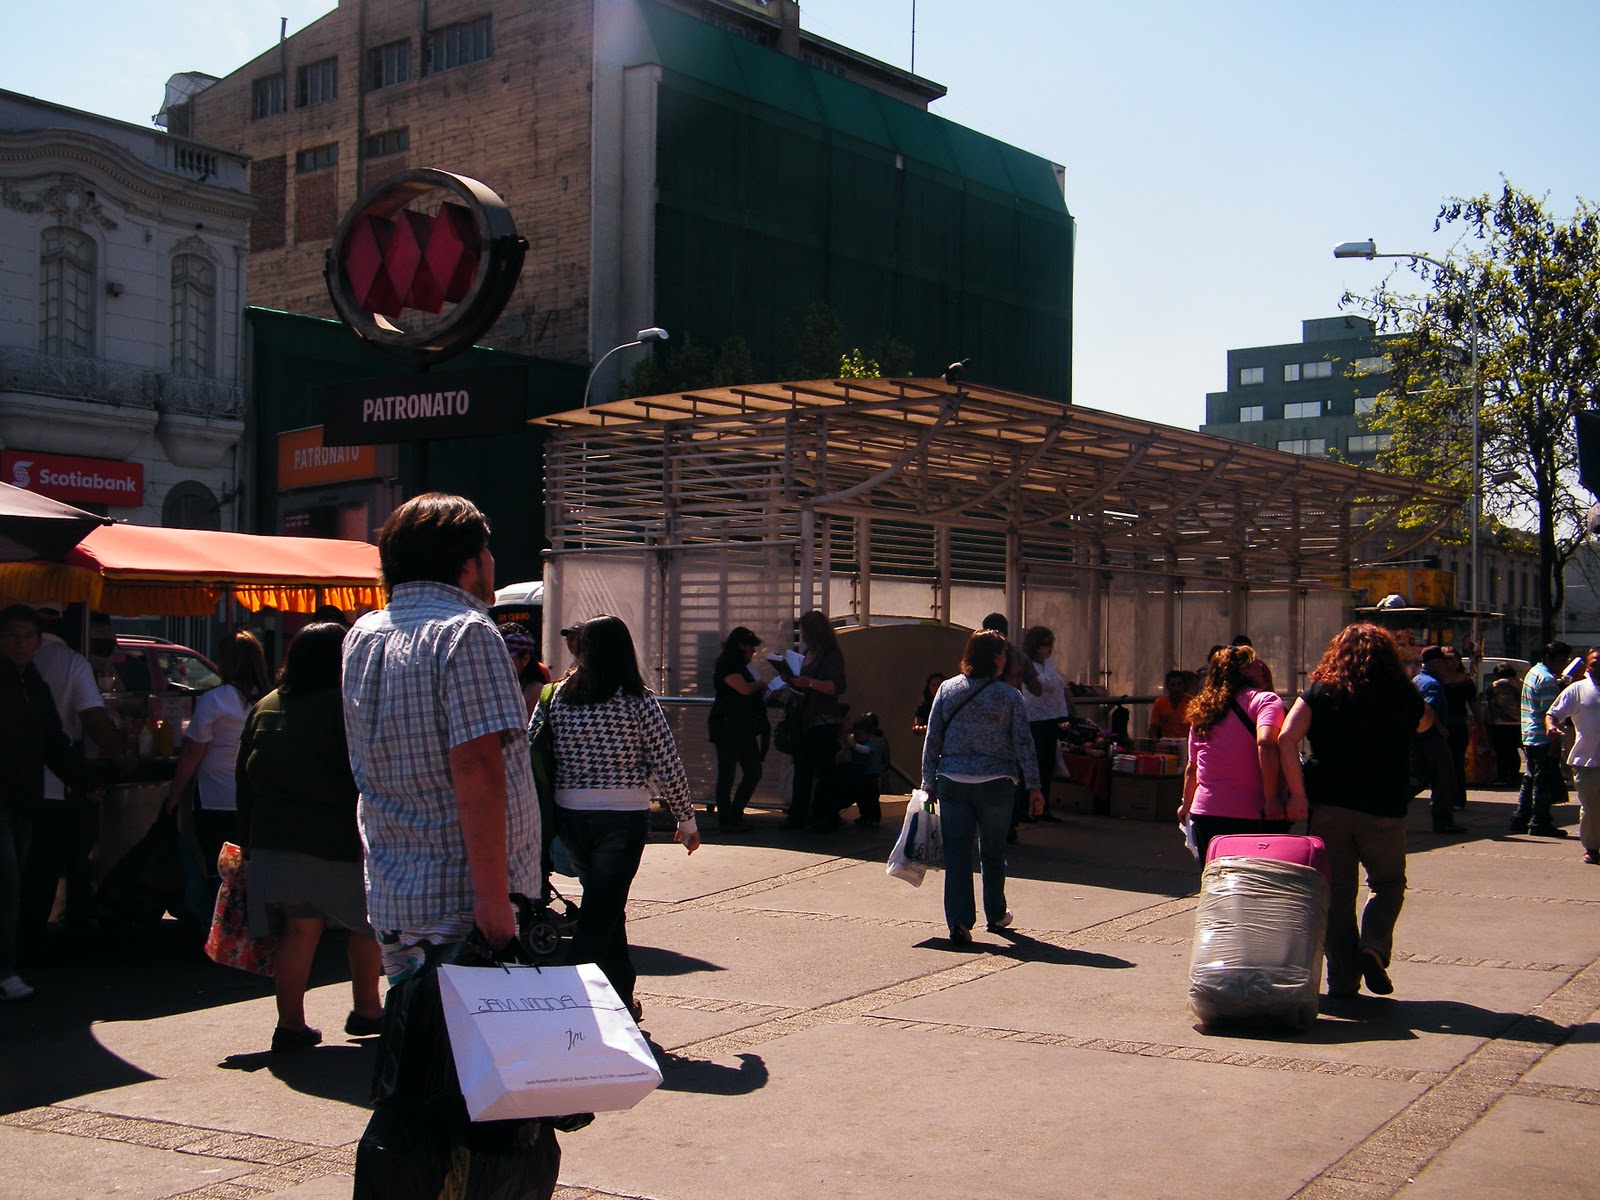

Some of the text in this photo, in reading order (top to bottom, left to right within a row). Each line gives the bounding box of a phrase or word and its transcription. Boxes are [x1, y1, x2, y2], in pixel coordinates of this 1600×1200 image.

[362, 390, 469, 423] PATRONATO
[294, 445, 360, 470] PATRONATO
[40, 469, 136, 492] Scotiabank
